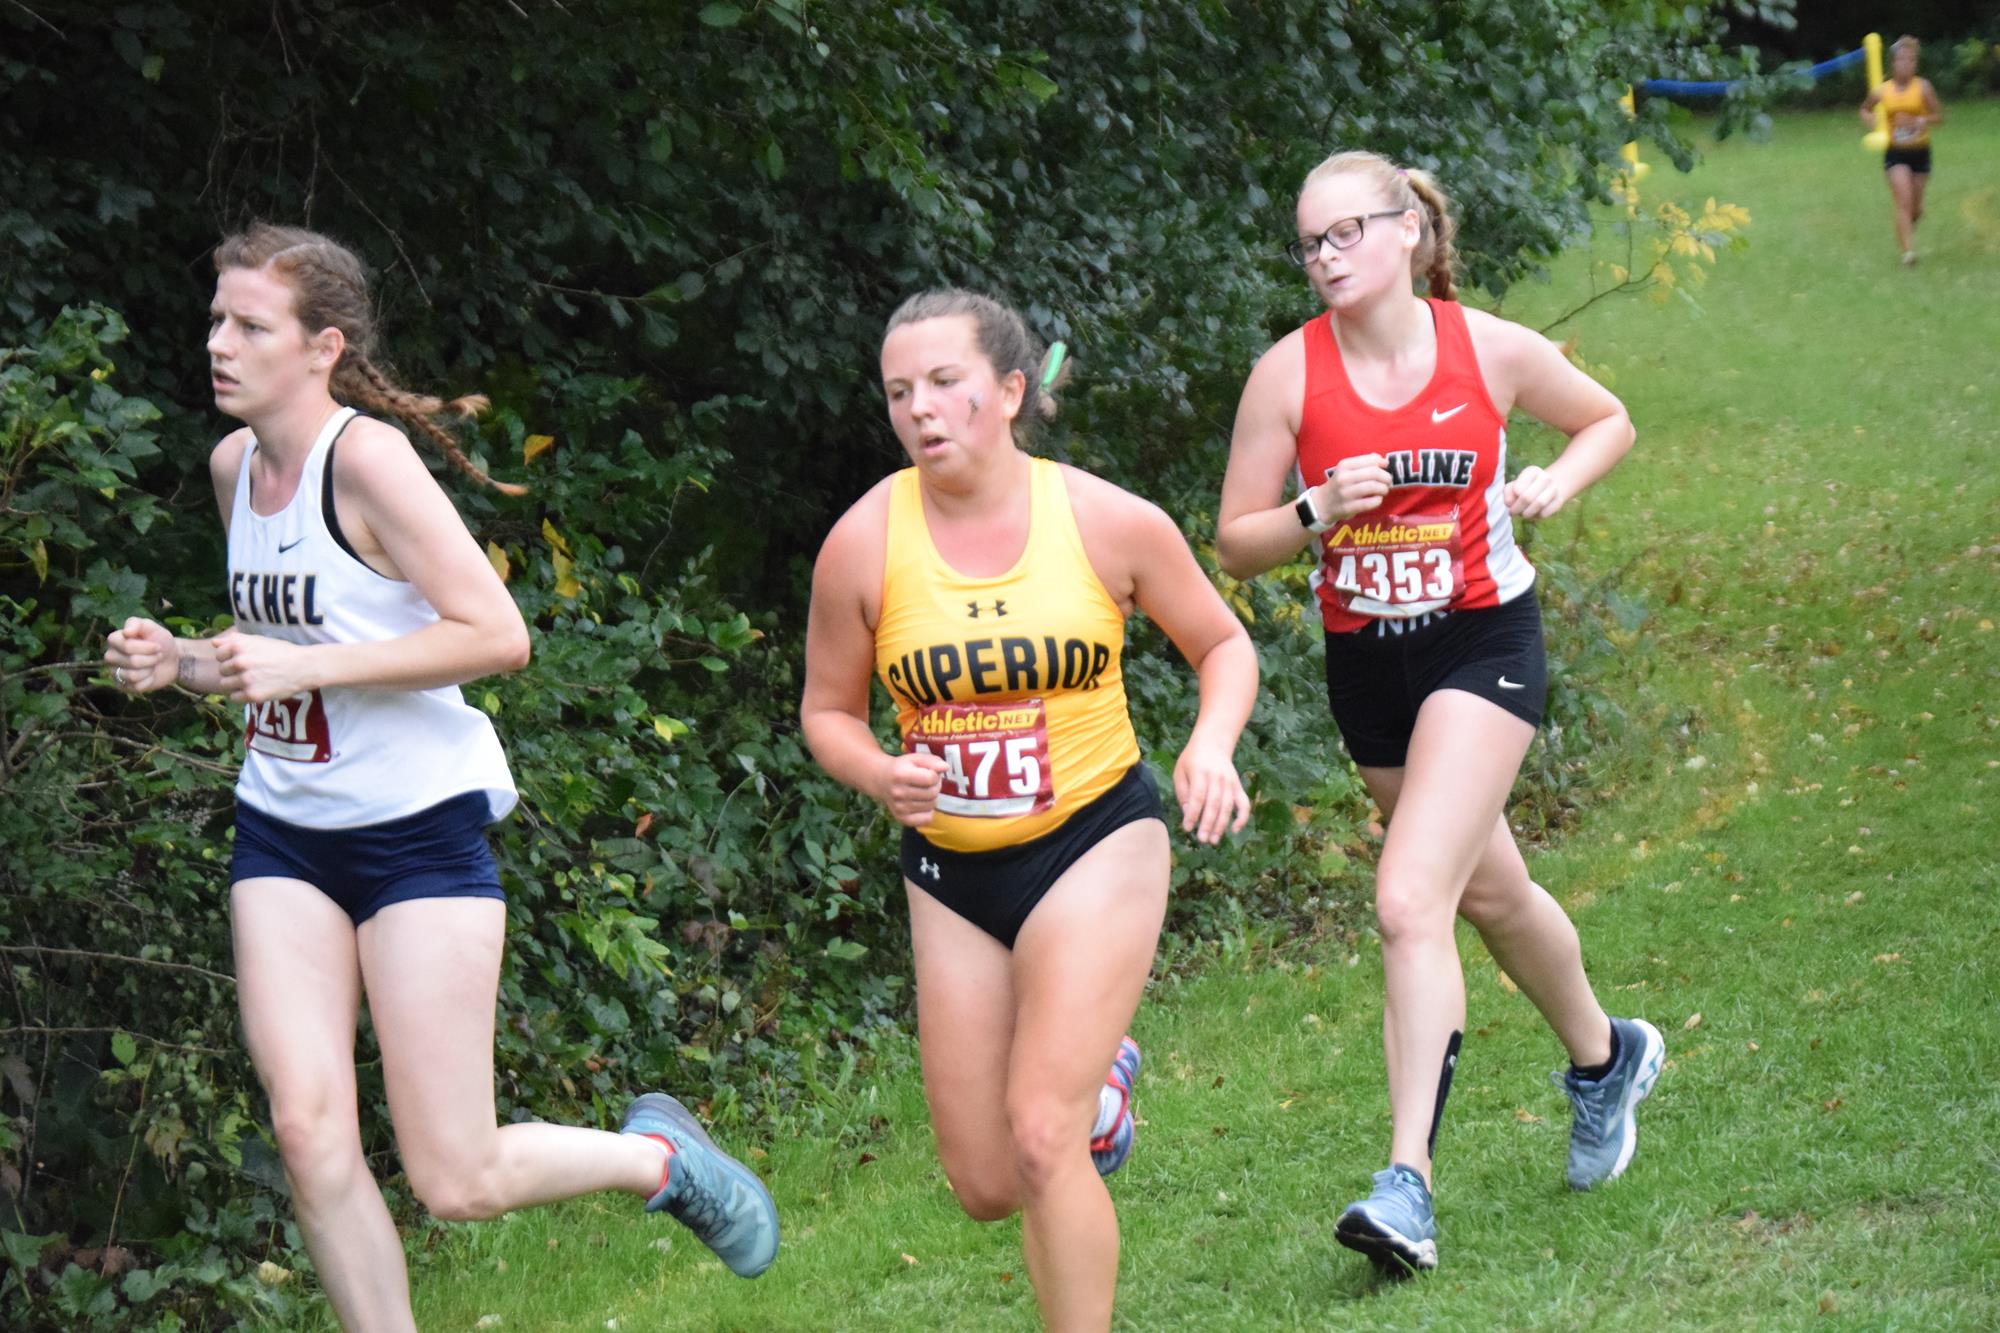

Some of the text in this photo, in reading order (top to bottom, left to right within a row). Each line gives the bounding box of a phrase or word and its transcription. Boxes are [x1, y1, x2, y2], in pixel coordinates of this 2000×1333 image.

[1325, 449, 1477, 487] LINE
[1327, 523, 1418, 547] Athletic
[232, 571, 324, 626] ETHEL
[1335, 548, 1454, 602] 4353
[888, 636, 1110, 708] SUPERIOR
[914, 708, 999, 735] thletic
[915, 736, 1041, 797] 475
